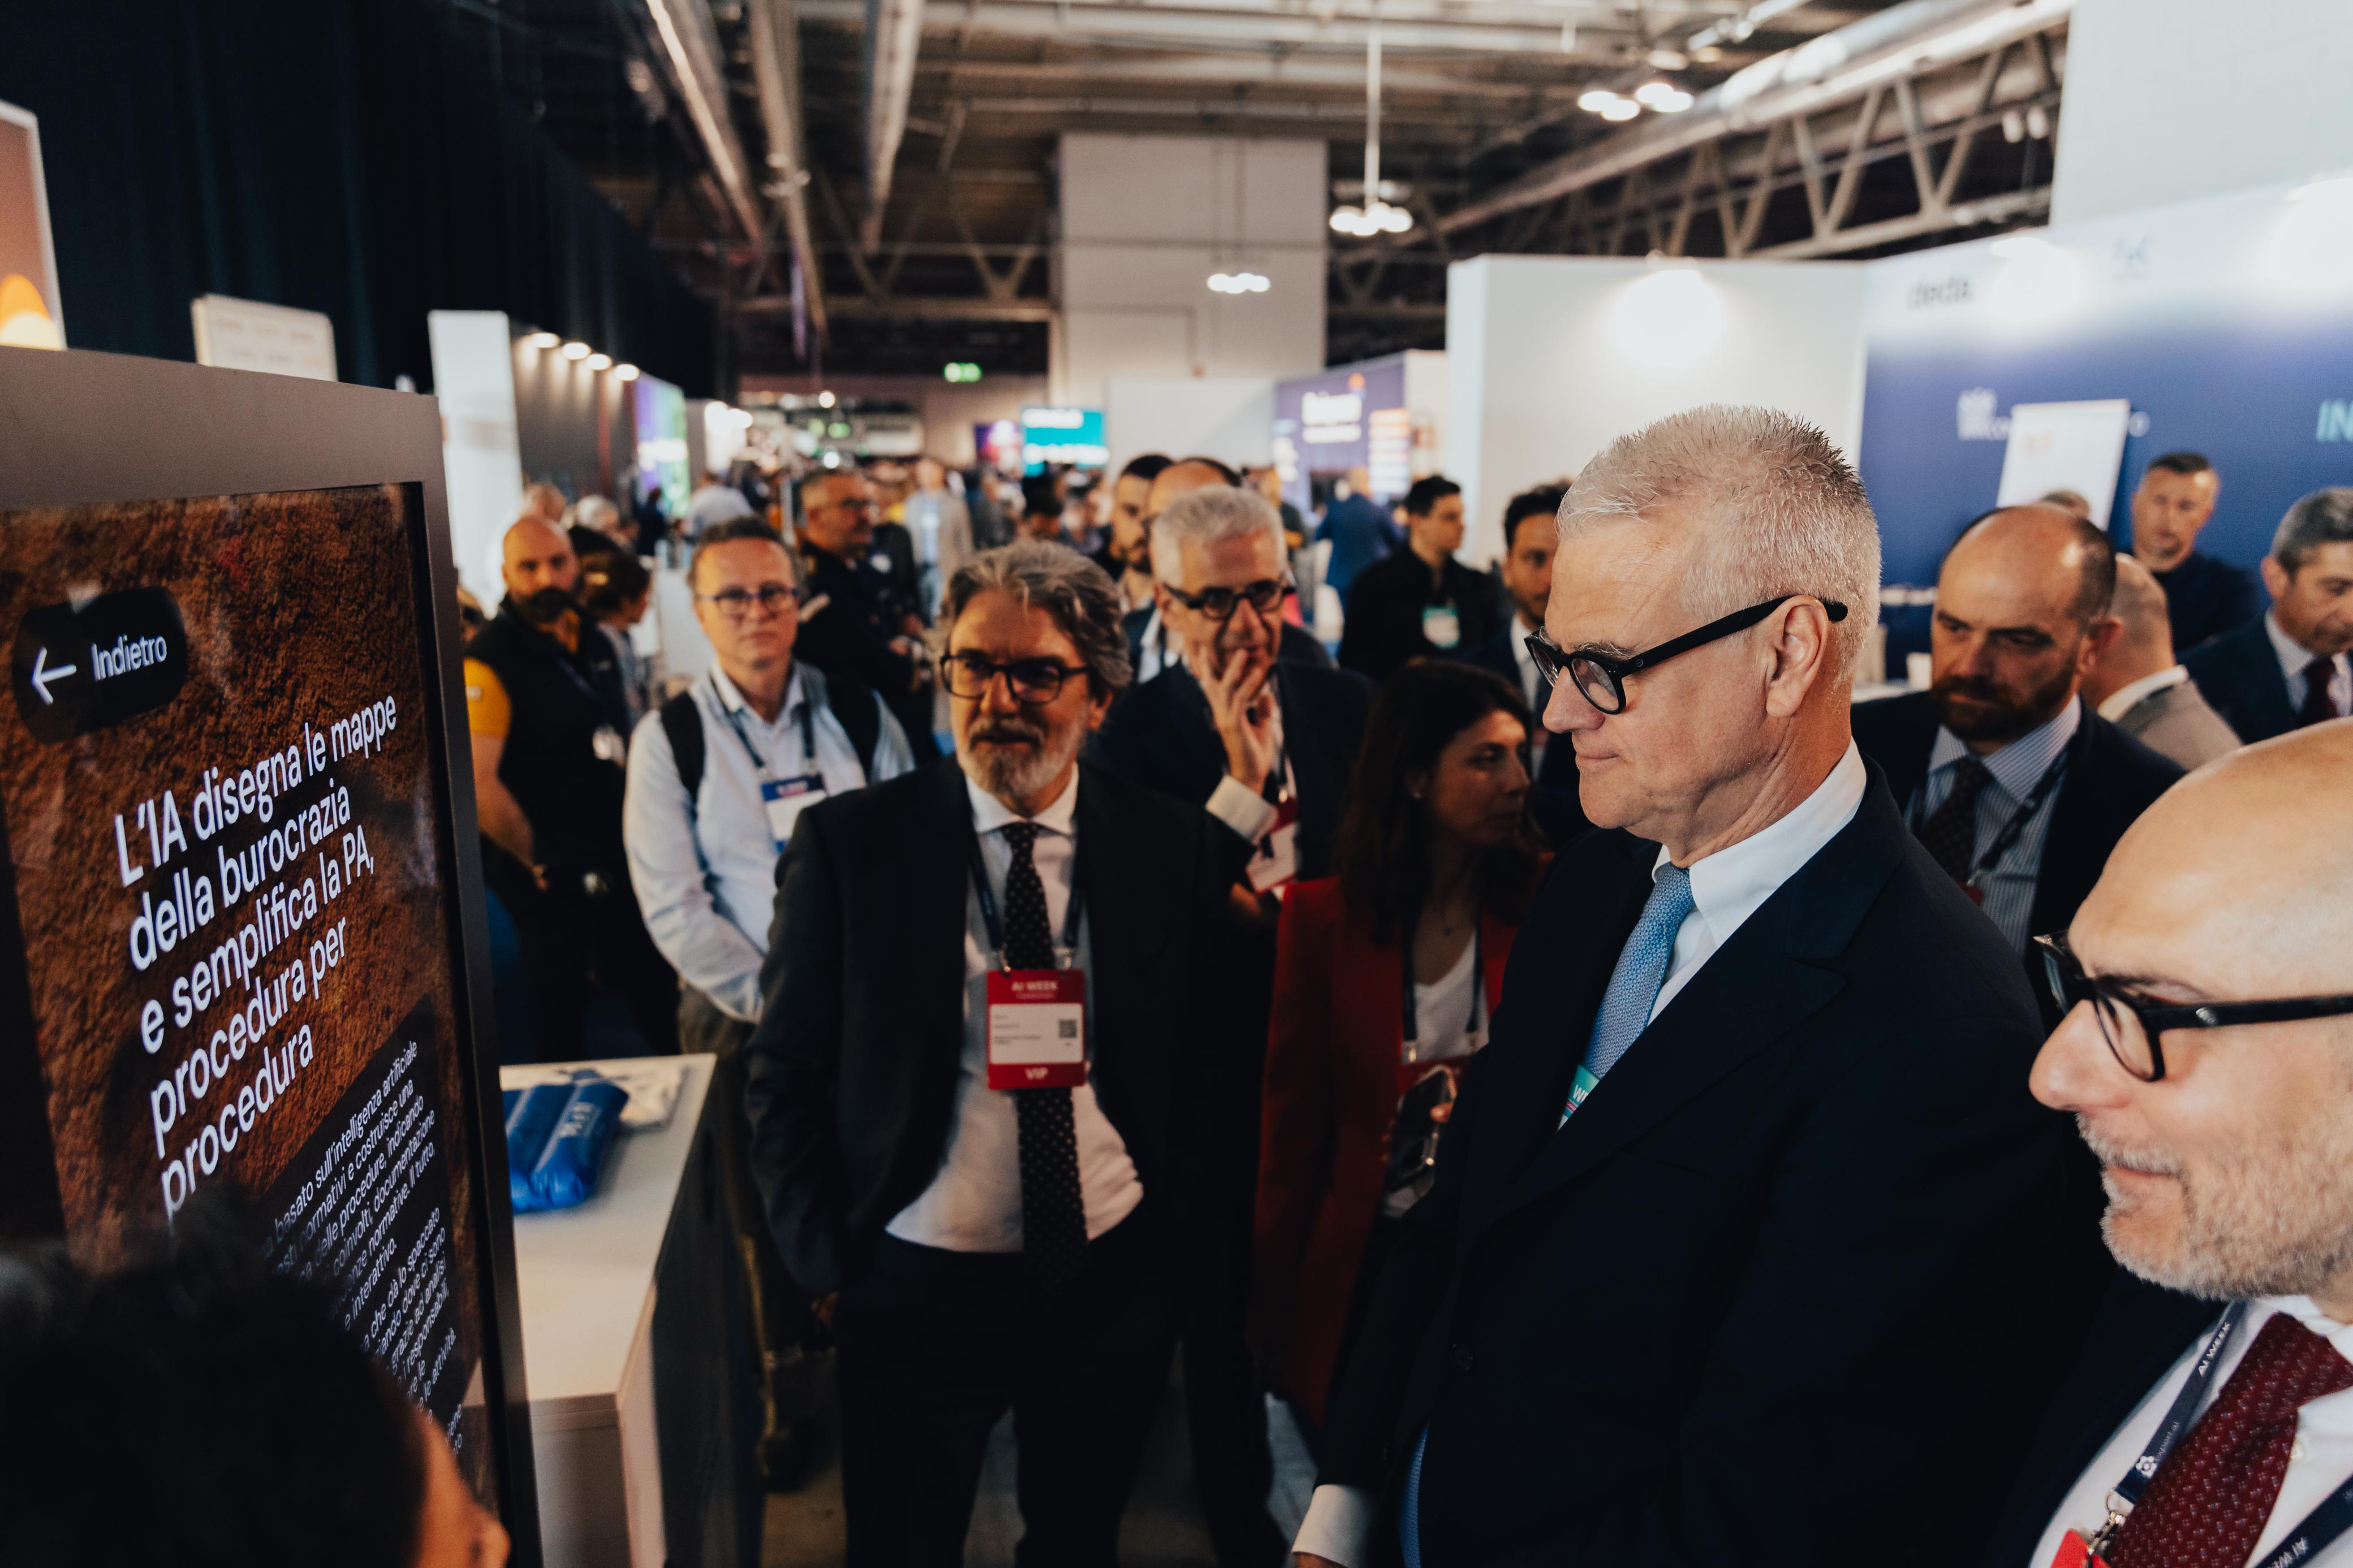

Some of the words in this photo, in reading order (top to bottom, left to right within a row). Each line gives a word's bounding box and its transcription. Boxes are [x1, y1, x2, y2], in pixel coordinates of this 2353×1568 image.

[90, 634, 167, 682] Indietro
[114, 789, 188, 888] L'IA
[193, 745, 302, 841] disegna
[304, 722, 326, 776] le
[331, 696, 396, 762] mappe
[130, 867, 215, 971] della
[218, 778, 351, 908] burocrazia
[141, 999, 165, 1055] e
[173, 882, 318, 1028] semplifica
[319, 852, 341, 905] la
[342, 825, 374, 885] PA,
[150, 959, 305, 1159] procedura
[311, 917, 346, 1000] per
[161, 1024, 313, 1220] procedura
[275, 1181, 313, 1243] basato
[316, 1089, 382, 1189] sull'intelligenza
[383, 1040, 417, 1098] artificiale
[299, 1167, 346, 1252] normativi
[348, 1163, 354, 1181] e
[355, 1100, 398, 1169] costruisce
[399, 1079, 414, 1107] una
[314, 1222, 338, 1266] delle
[339, 1153, 387, 1237] procedure,
[386, 1095, 424, 1158] indicando
[334, 1202, 373, 1276] coinvolti,
[373, 1109, 435, 1212] documentazione
[368, 1183, 410, 1256] normative.
[415, 1142, 435, 1178] tutto,
[371, 1303, 386, 1338] che
[387, 1279, 399, 1307] dà
[398, 1267, 407, 1288] lo
[407, 1207, 439, 1272] spaccato
[402, 1273, 420, 1314] dove
[421, 1250, 428, 1278] ci
[429, 1228, 445, 1264] sono
[352, 1238, 397, 1320] interattivo.
[392, 1319, 414, 1375] grazie
[414, 1292, 424, 1324] ad
[425, 1251, 446, 1304] analisi
[405, 1277, 449, 1373] responsabili,
[417, 1360, 425, 1381] le
[424, 1380, 432, 1402] le
